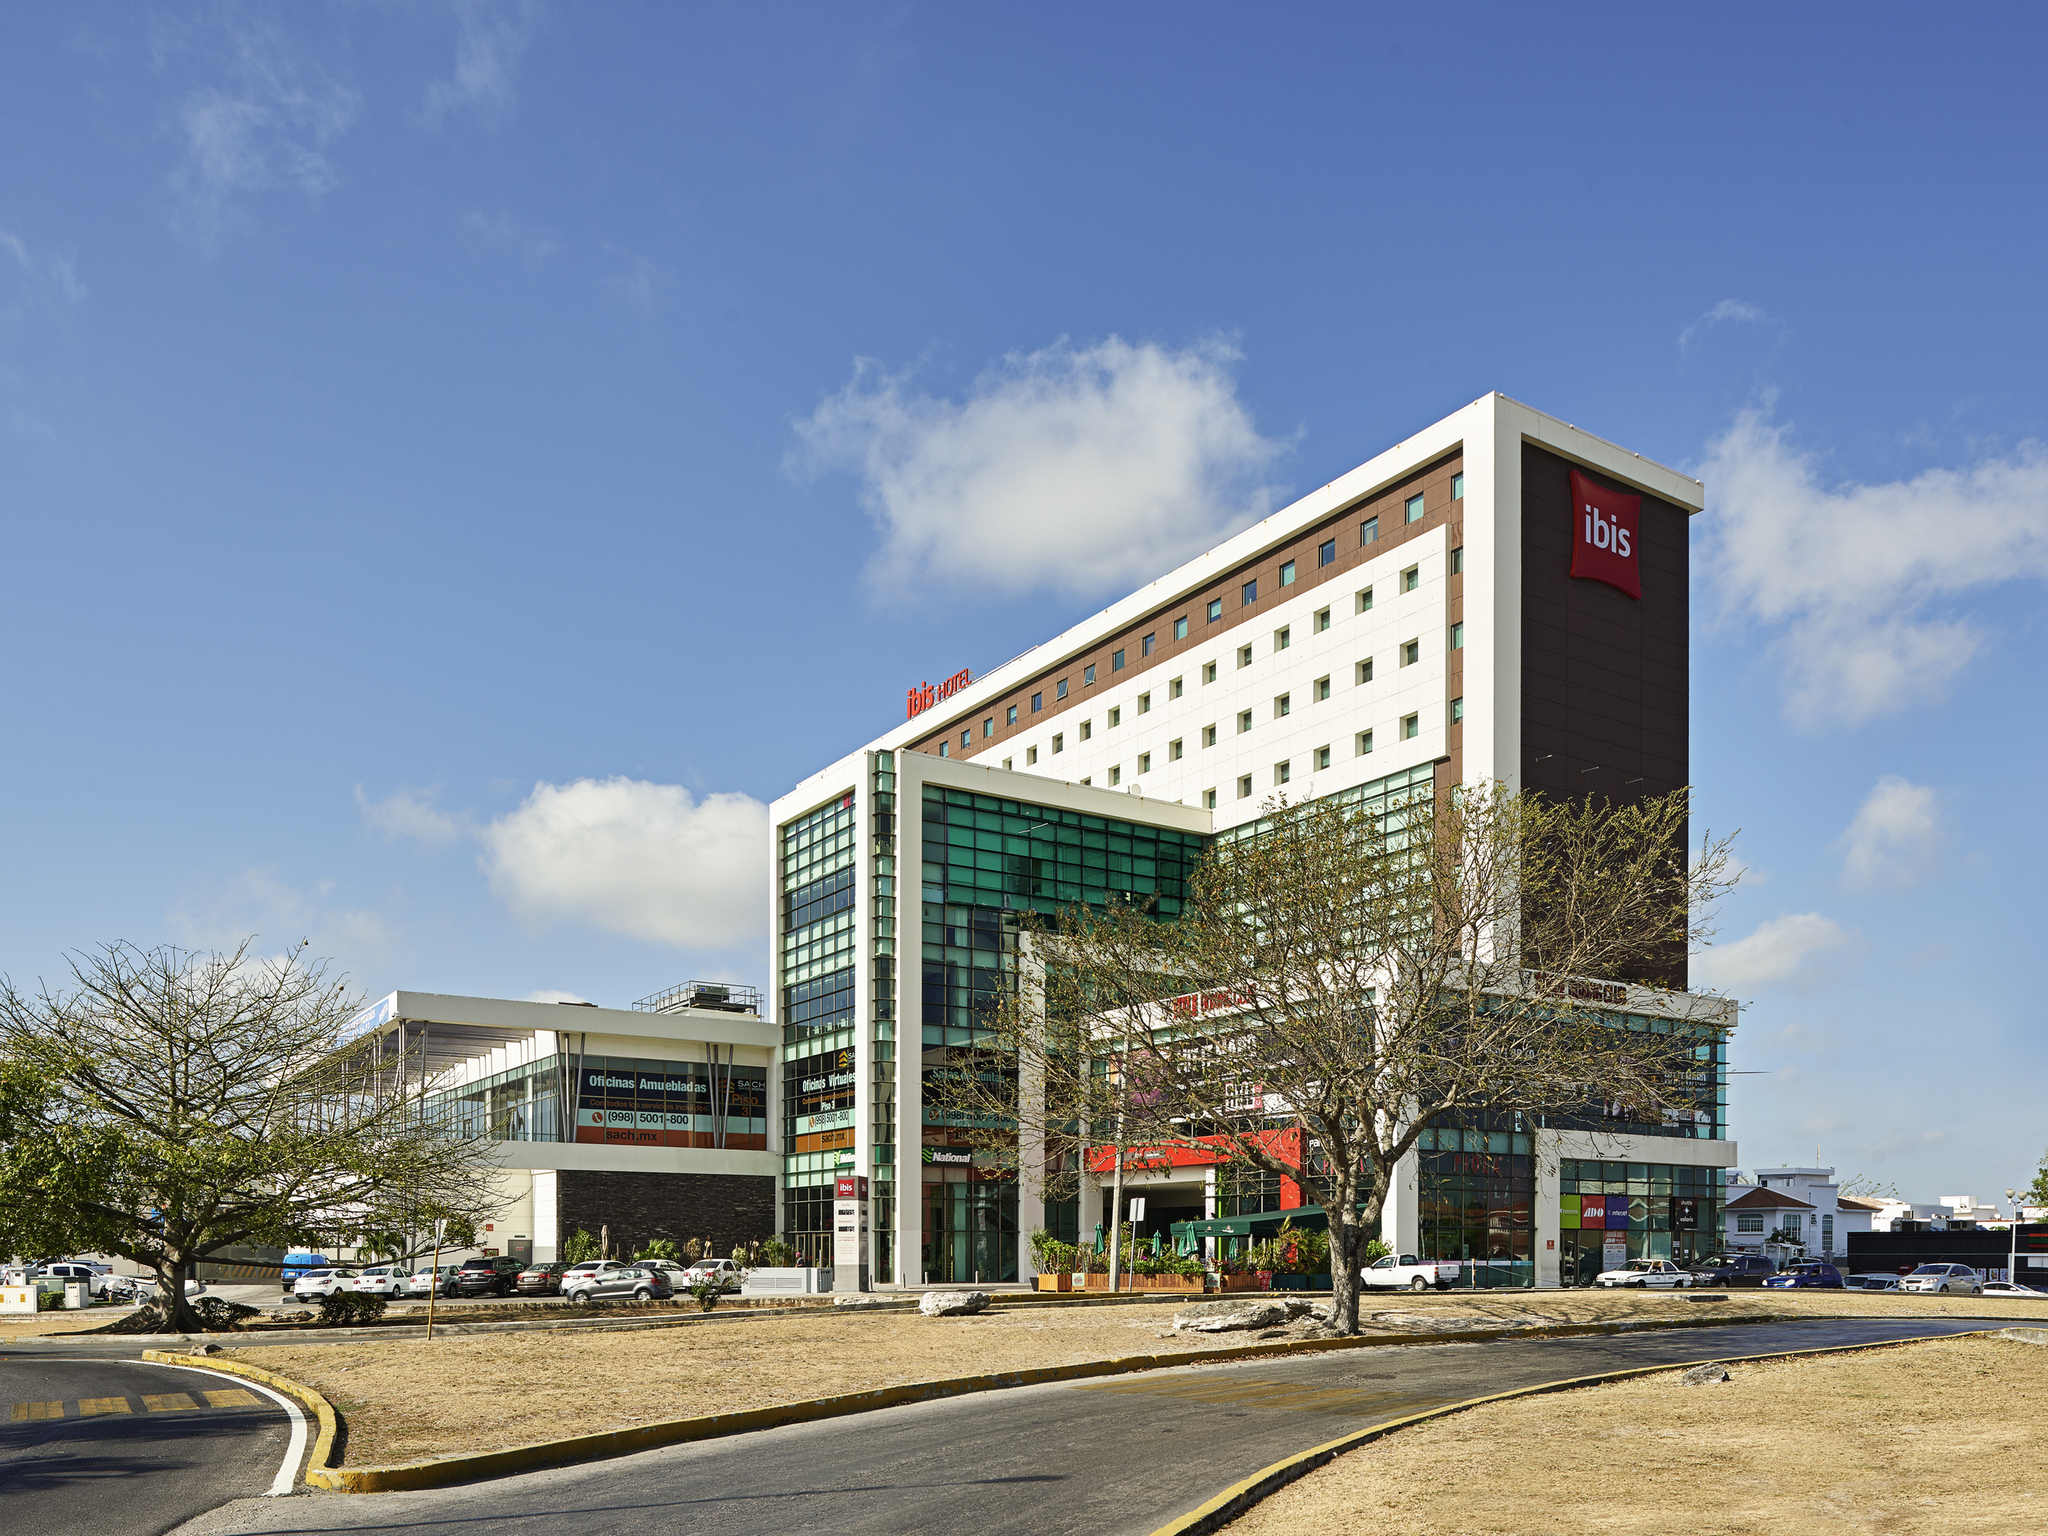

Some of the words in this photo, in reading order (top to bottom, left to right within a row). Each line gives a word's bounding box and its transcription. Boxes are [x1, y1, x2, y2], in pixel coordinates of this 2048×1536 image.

[1585, 504, 1631, 558] ibis
[906, 680, 935, 720] ibis
[937, 668, 972, 701] HOTEL
[589, 1074, 636, 1089] Oficinas
[640, 1078, 707, 1093] Amuebladas
[803, 1078, 827, 1093] Oficinas
[829, 1071, 856, 1088] Virtuales
[608, 1111, 634, 1123] (998)
[606, 1129, 657, 1142] sach.mx
[932, 1151, 971, 1163] National
[840, 1183, 853, 1192] ibis
[1584, 1207, 1604, 1218] ADO
